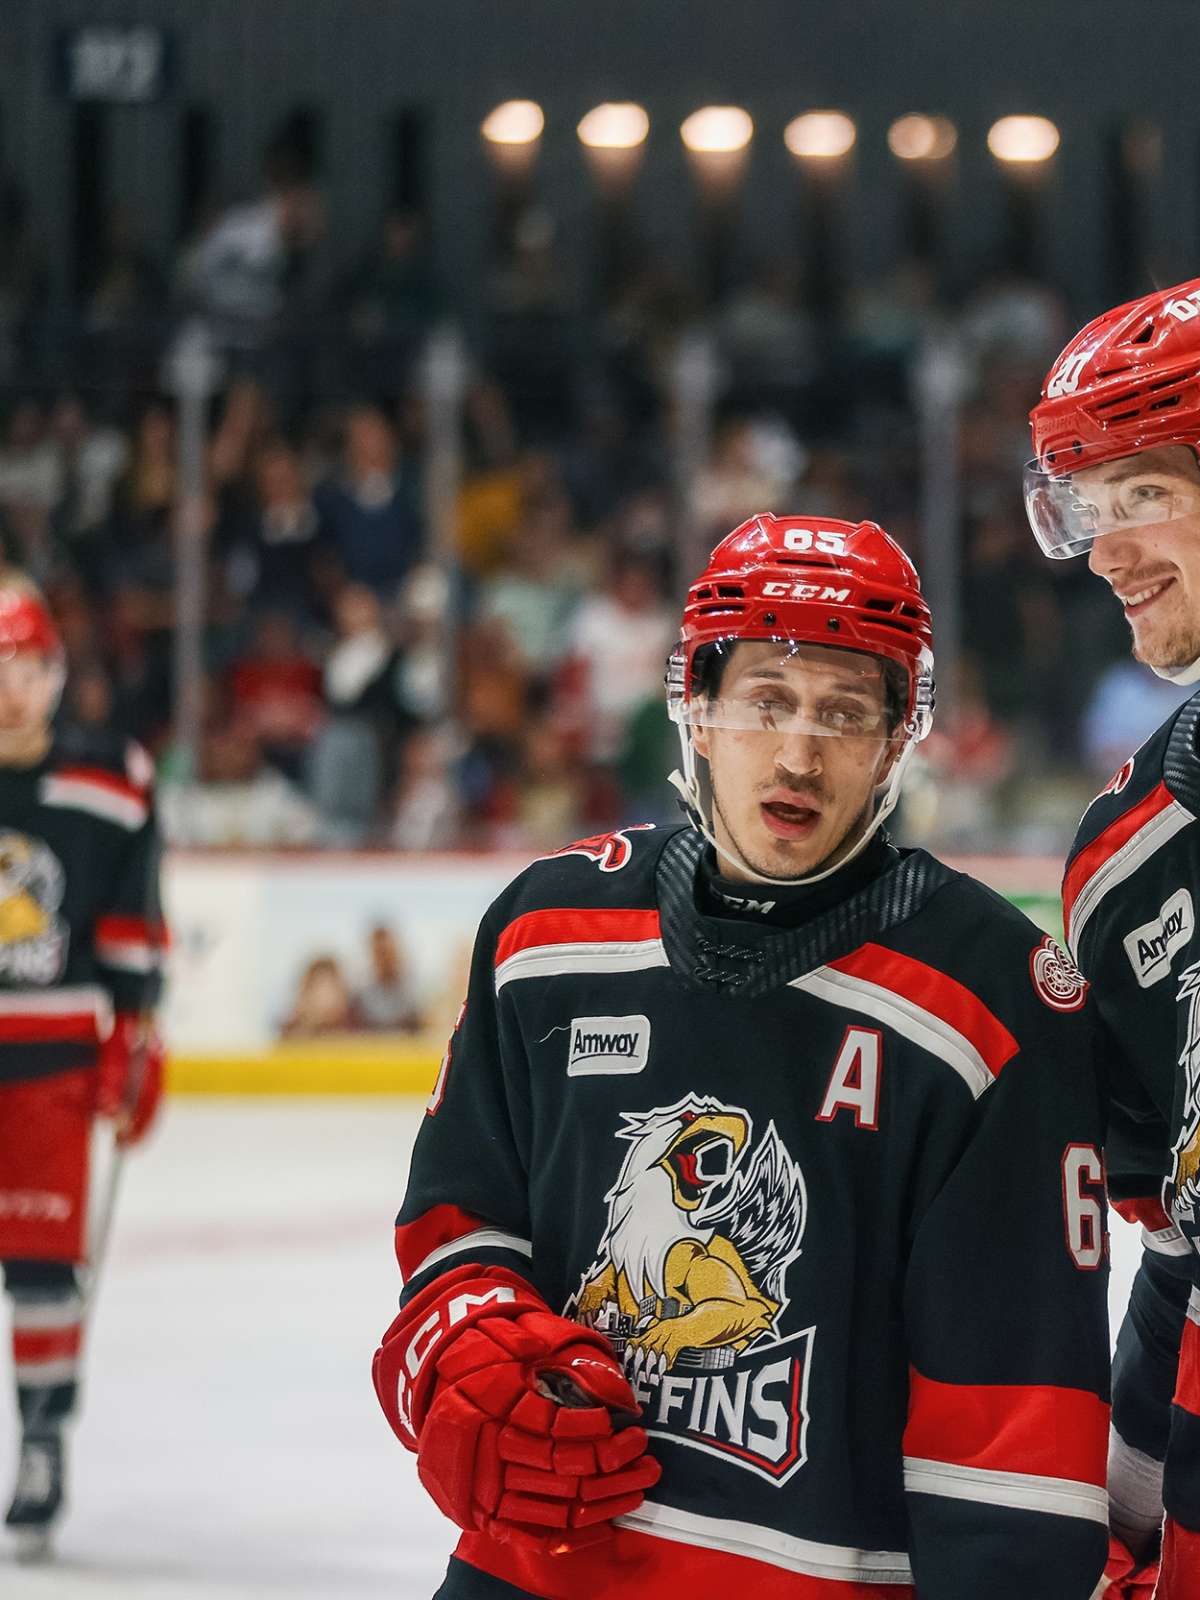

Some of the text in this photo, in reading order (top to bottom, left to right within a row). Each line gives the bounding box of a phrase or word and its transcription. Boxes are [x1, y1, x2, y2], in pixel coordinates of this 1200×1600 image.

[783, 529, 849, 557] 65
[762, 582, 850, 601] CCM
[1137, 907, 1183, 966] Amay
[573, 1029, 640, 1057] Amway
[815, 1025, 883, 1131] A
[1061, 1142, 1110, 1271] 6
[397, 1286, 516, 1440] CCM
[632, 1357, 792, 1463] FFINS
